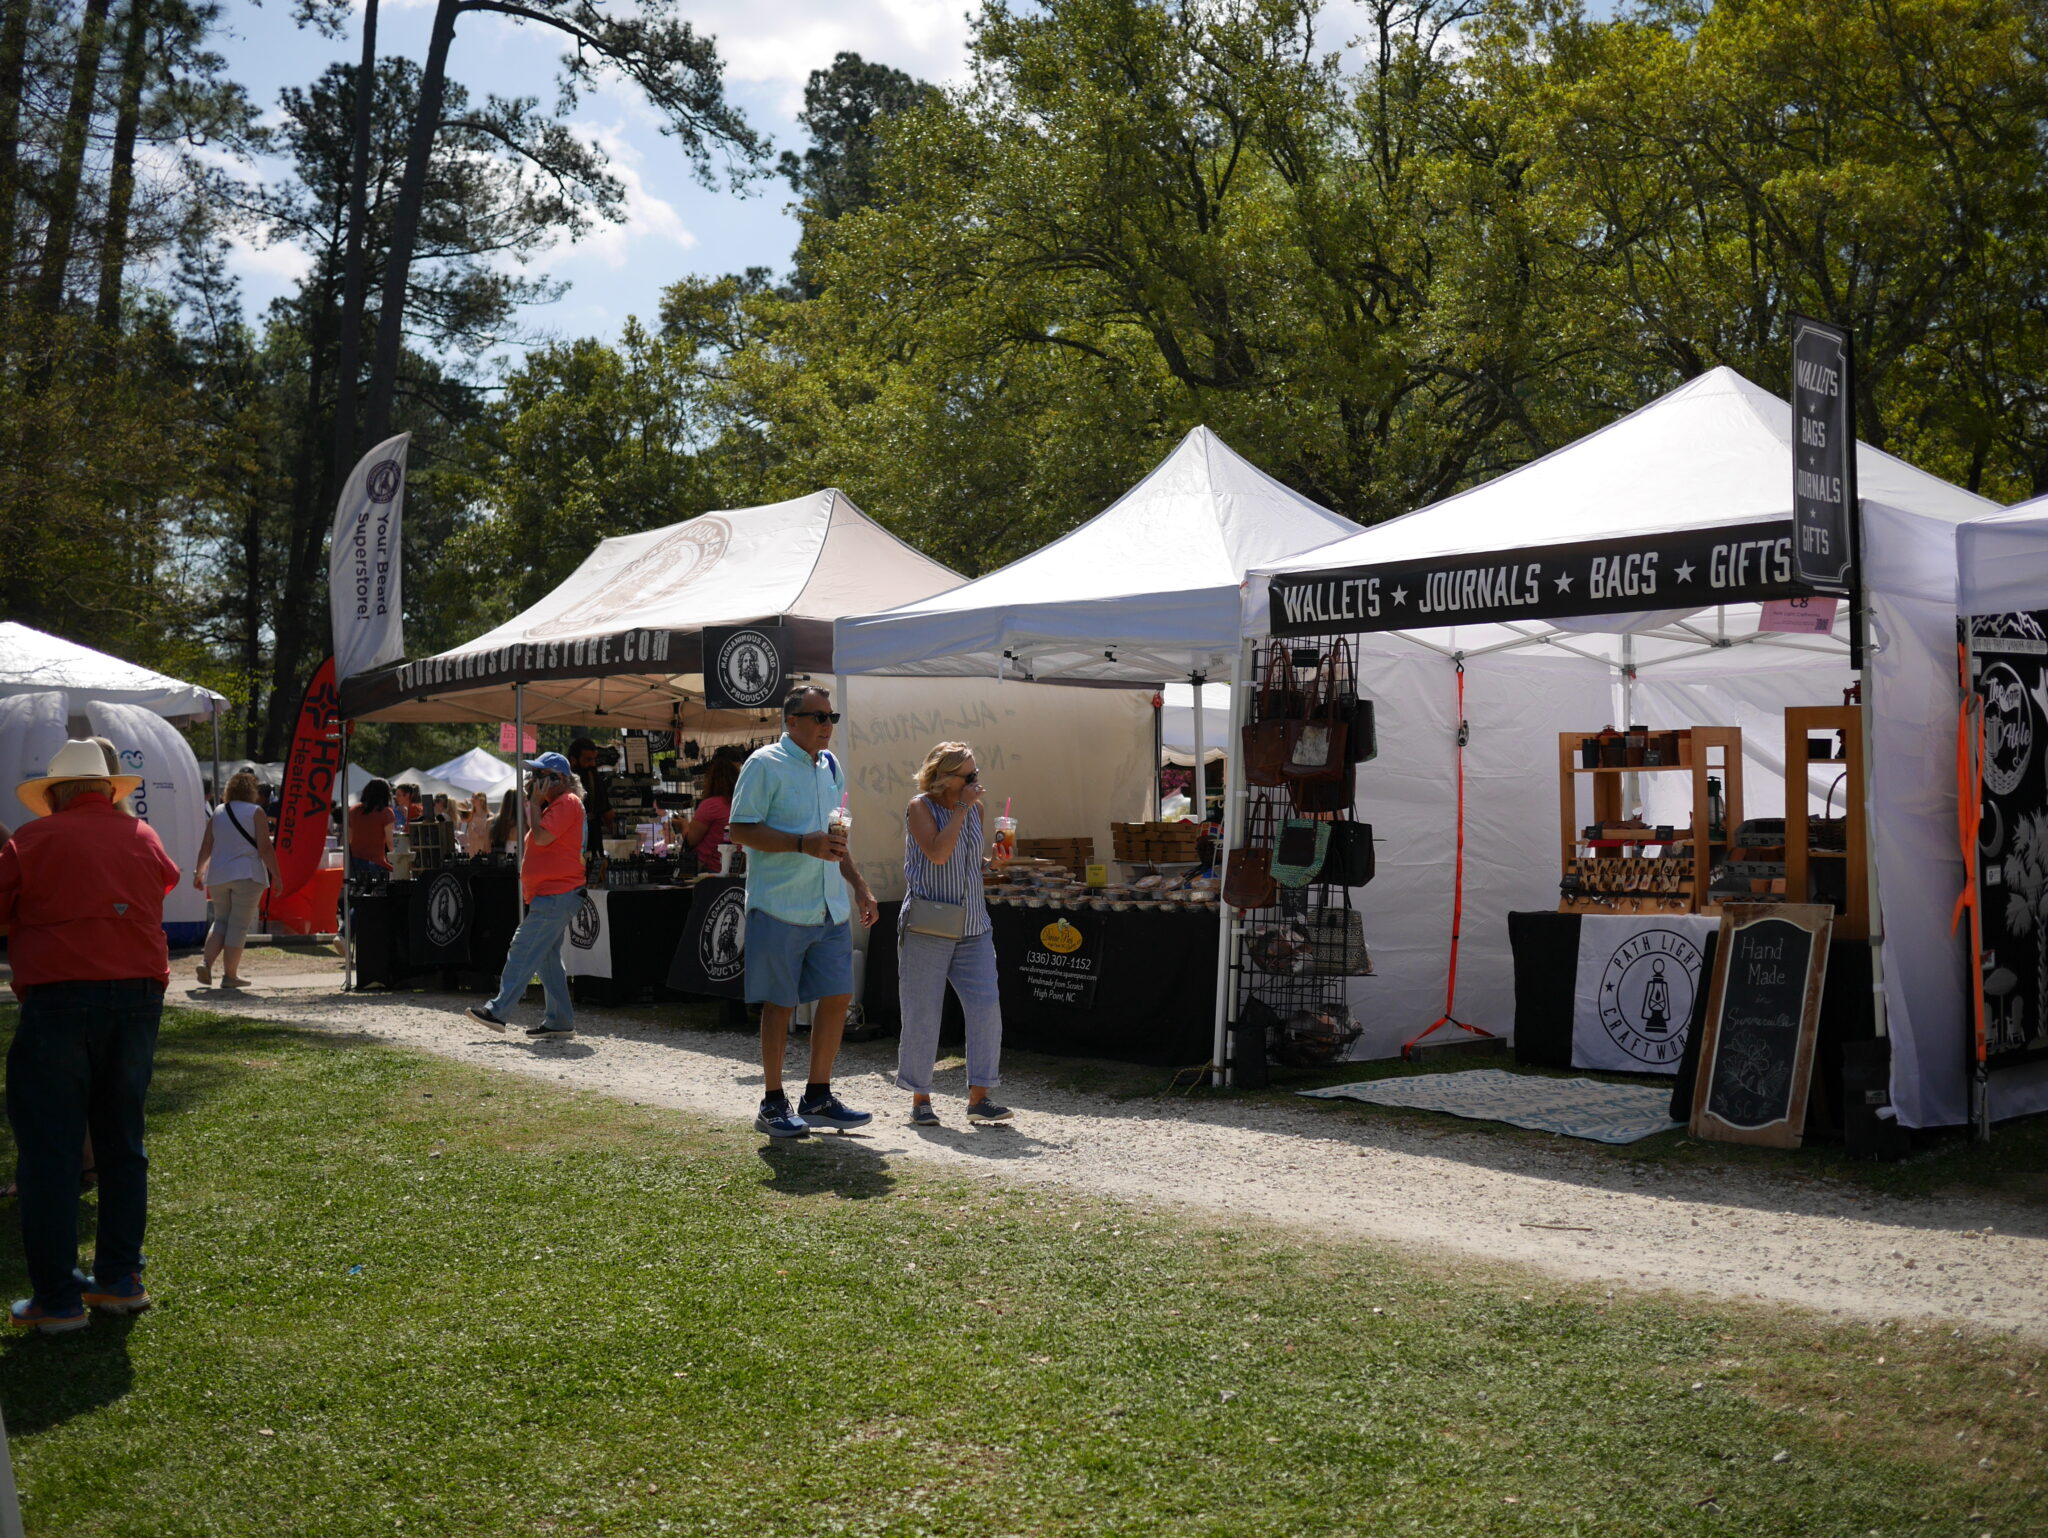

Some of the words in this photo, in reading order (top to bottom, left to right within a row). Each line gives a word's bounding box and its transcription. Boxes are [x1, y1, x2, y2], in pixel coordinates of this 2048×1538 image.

[1797, 359, 1838, 396] WALLETS
[1802, 416, 1826, 448] BAGS
[376, 512, 390, 556] Your
[1802, 527, 1829, 555] GIFTS
[355, 512, 370, 621] Superstore!
[1283, 577, 1380, 624] WALLETS
[1419, 563, 1542, 614] JOURNALS
[1589, 551, 1660, 600] BAGS
[1709, 537, 1793, 591] GIFTS
[376, 559, 390, 617] Beard
[721, 634, 763, 669] MAGNANIMOUS
[761, 641, 777, 669] BEARD
[730, 687, 769, 703] PRODUCTS
[1984, 676, 2006, 702] The
[2004, 722, 2032, 750] Hole
[281, 737, 311, 850] Healthcare
[304, 738, 337, 818] HCA
[1026, 950, 1050, 966] (336)
[1050, 954, 1092, 971] 307-1152
[1614, 938, 1651, 970] PATH
[1661, 935, 1703, 973] LIGHT
[1740, 936, 1784, 961] Hand
[1027, 975, 1053, 988] Handmade
[1053, 979, 1066, 990] from
[1066, 980, 1084, 992] Scratch
[1748, 963, 1786, 986] Made
[1033, 987, 1048, 1001] High
[1065, 991, 1076, 1003] NC
